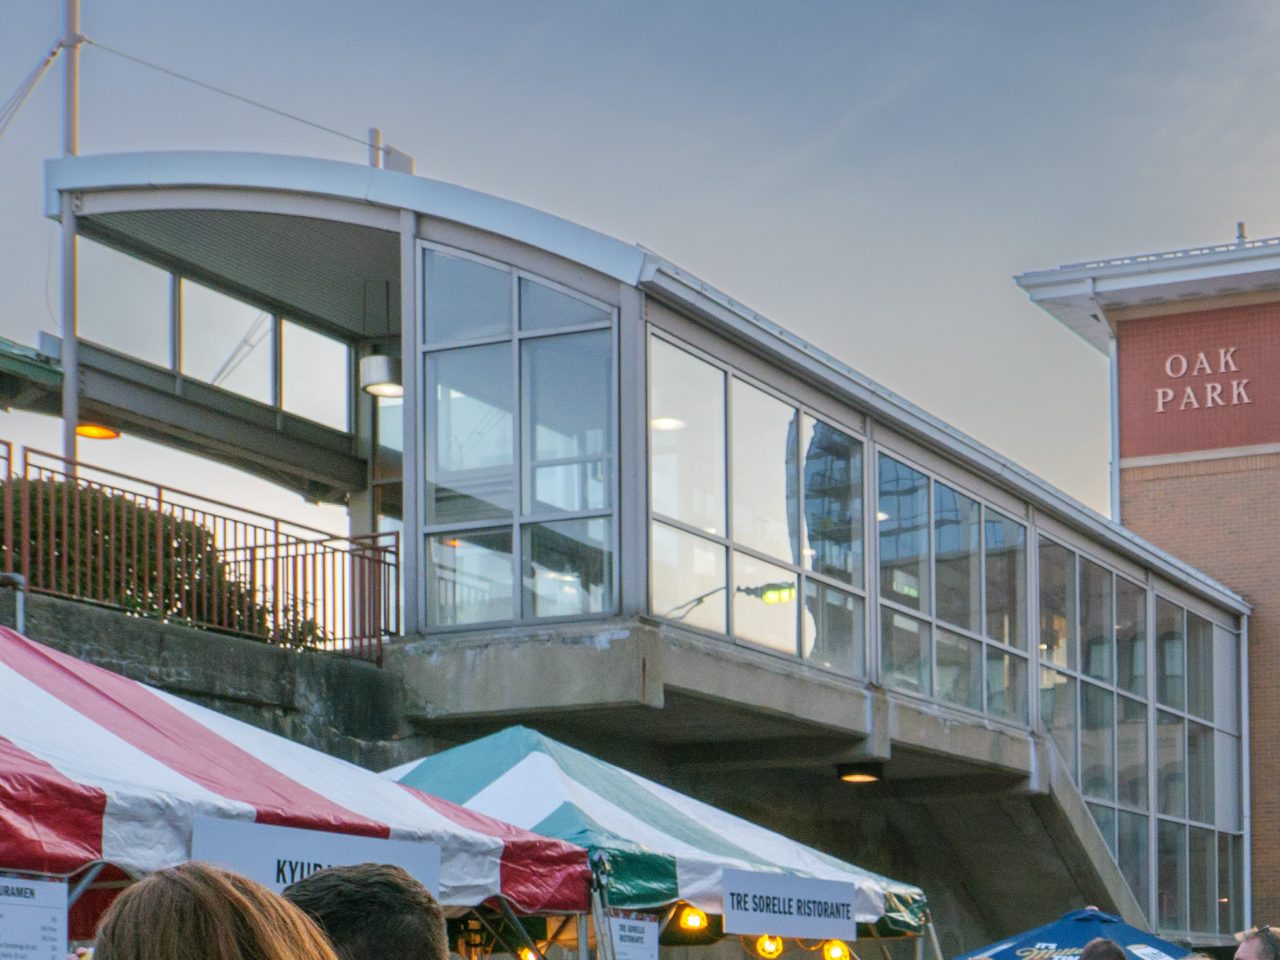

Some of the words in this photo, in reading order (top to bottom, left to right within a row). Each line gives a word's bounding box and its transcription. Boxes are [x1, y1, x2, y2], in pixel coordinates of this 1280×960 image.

[1165, 347, 1240, 378] OAK
[1154, 378, 1253, 413] PARK
[729, 892, 749, 911] TRE
[752, 894, 794, 915] SORELLE
[796, 899, 852, 920] RISTORANTE
